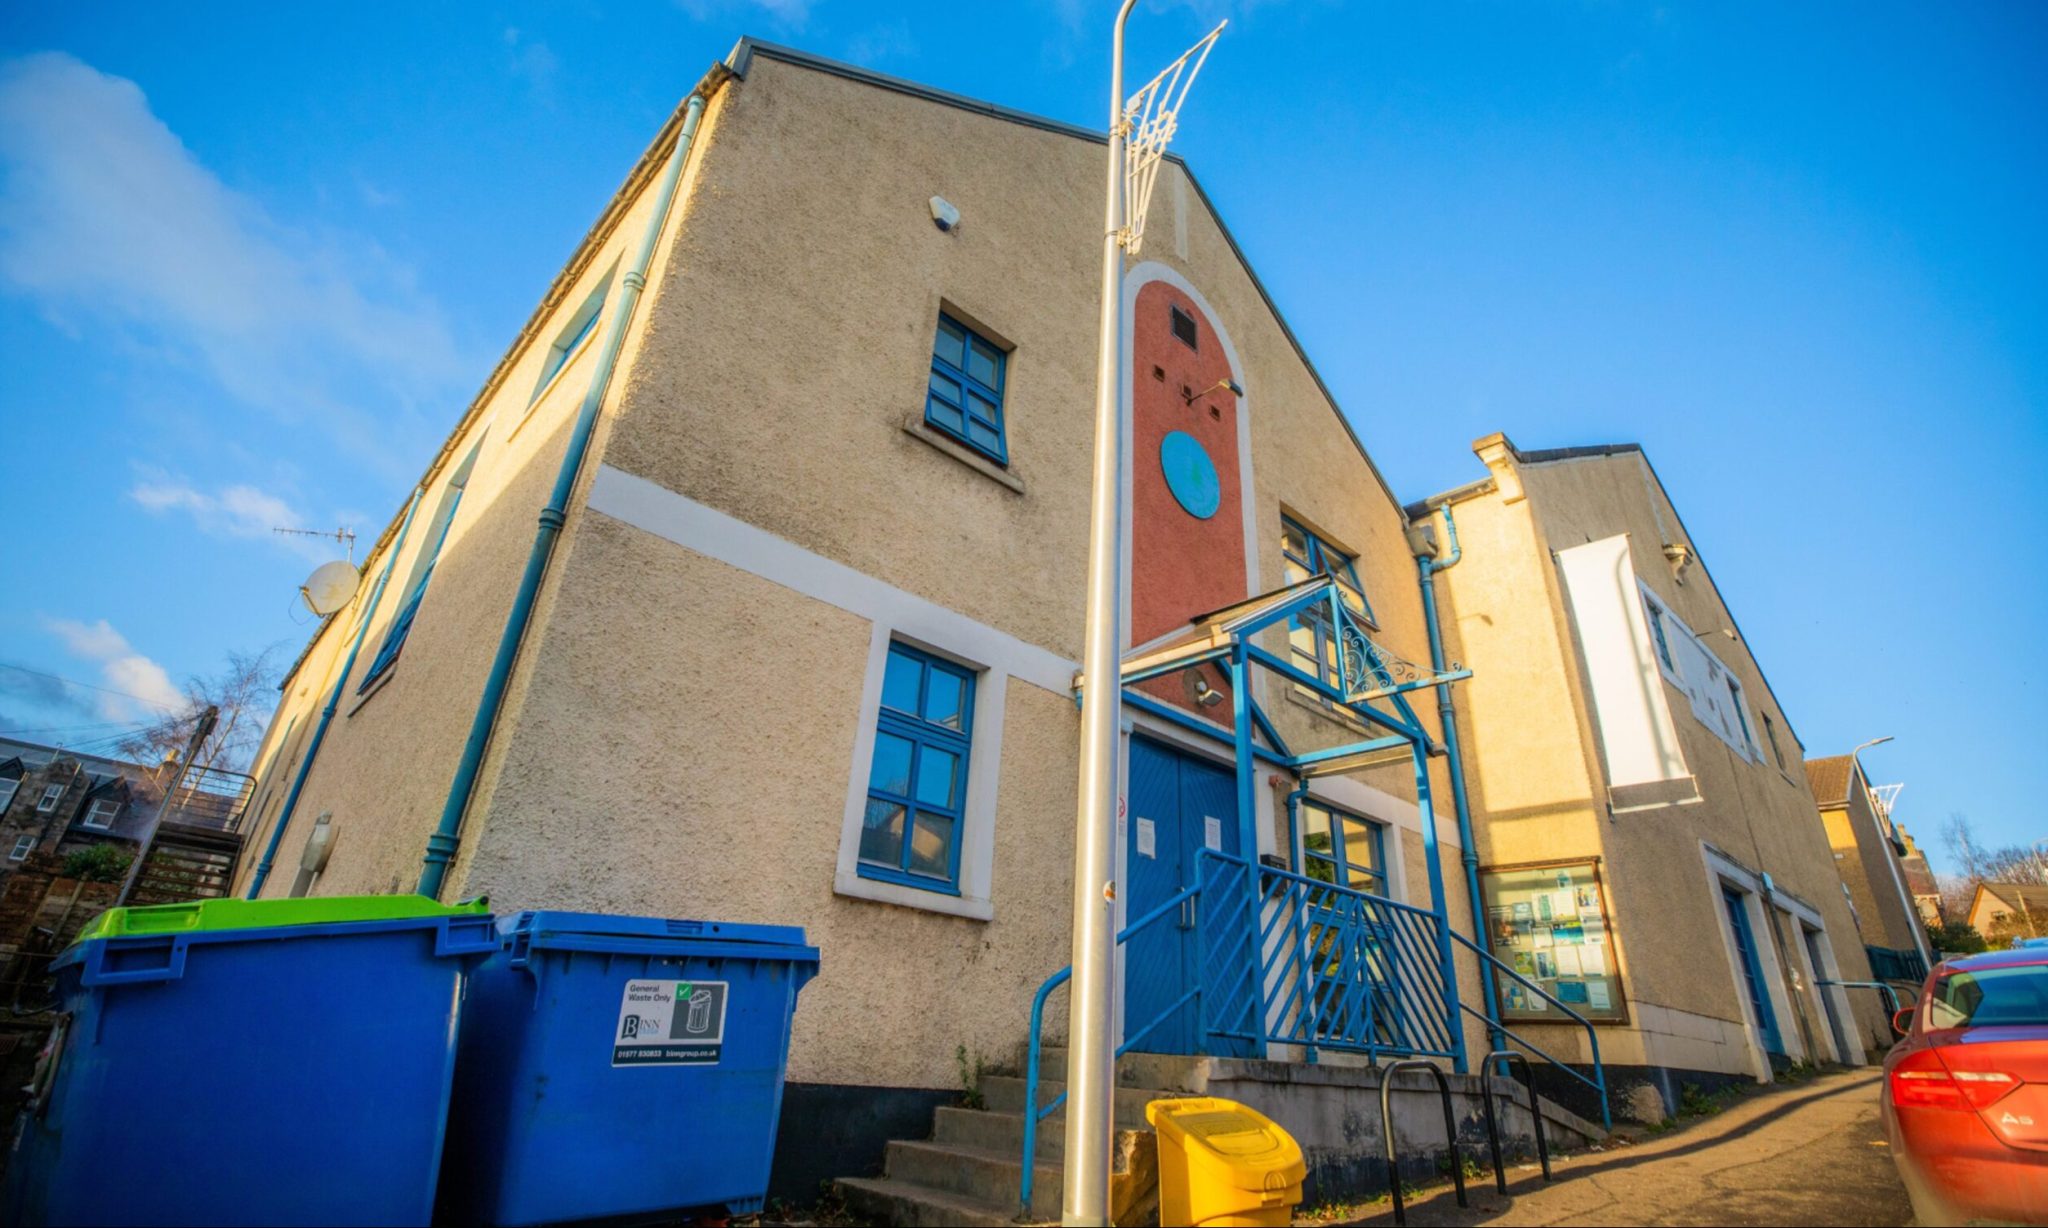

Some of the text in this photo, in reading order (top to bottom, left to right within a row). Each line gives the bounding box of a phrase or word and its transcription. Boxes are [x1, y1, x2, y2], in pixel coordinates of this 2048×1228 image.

[630, 984, 660, 992] General
[628, 994, 672, 1003] Waste Only
[623, 1016, 660, 1037] BINN
